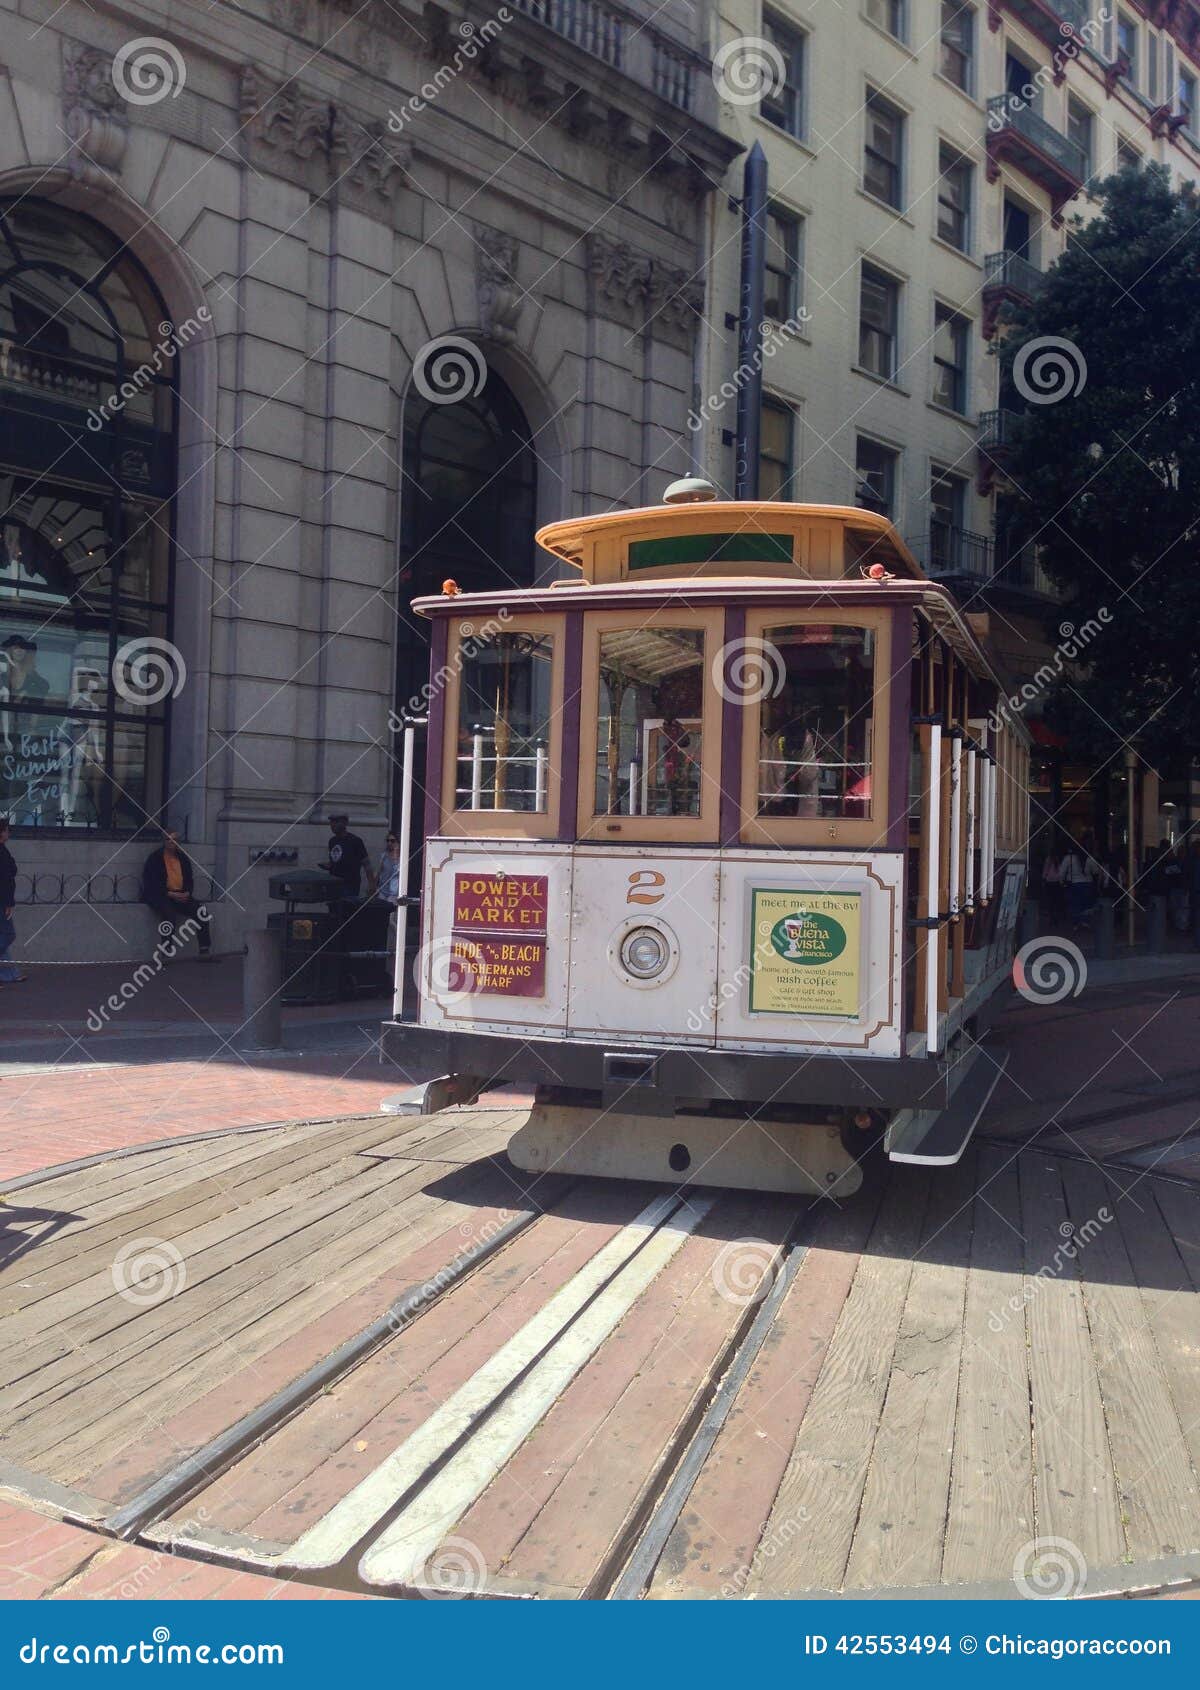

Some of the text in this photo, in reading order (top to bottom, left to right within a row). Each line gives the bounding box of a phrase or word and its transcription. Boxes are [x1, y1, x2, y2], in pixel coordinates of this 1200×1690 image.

[21, 729, 58, 758] Best
[460, 880, 543, 896] POWELL
[627, 870, 665, 905] 2
[481, 896, 520, 908] AND
[457, 907, 543, 924] MARKET
[454, 942, 540, 961] HYDE AND BEACH
[460, 962, 531, 976] FISHERMANS
[476, 976, 513, 988] WHARF
